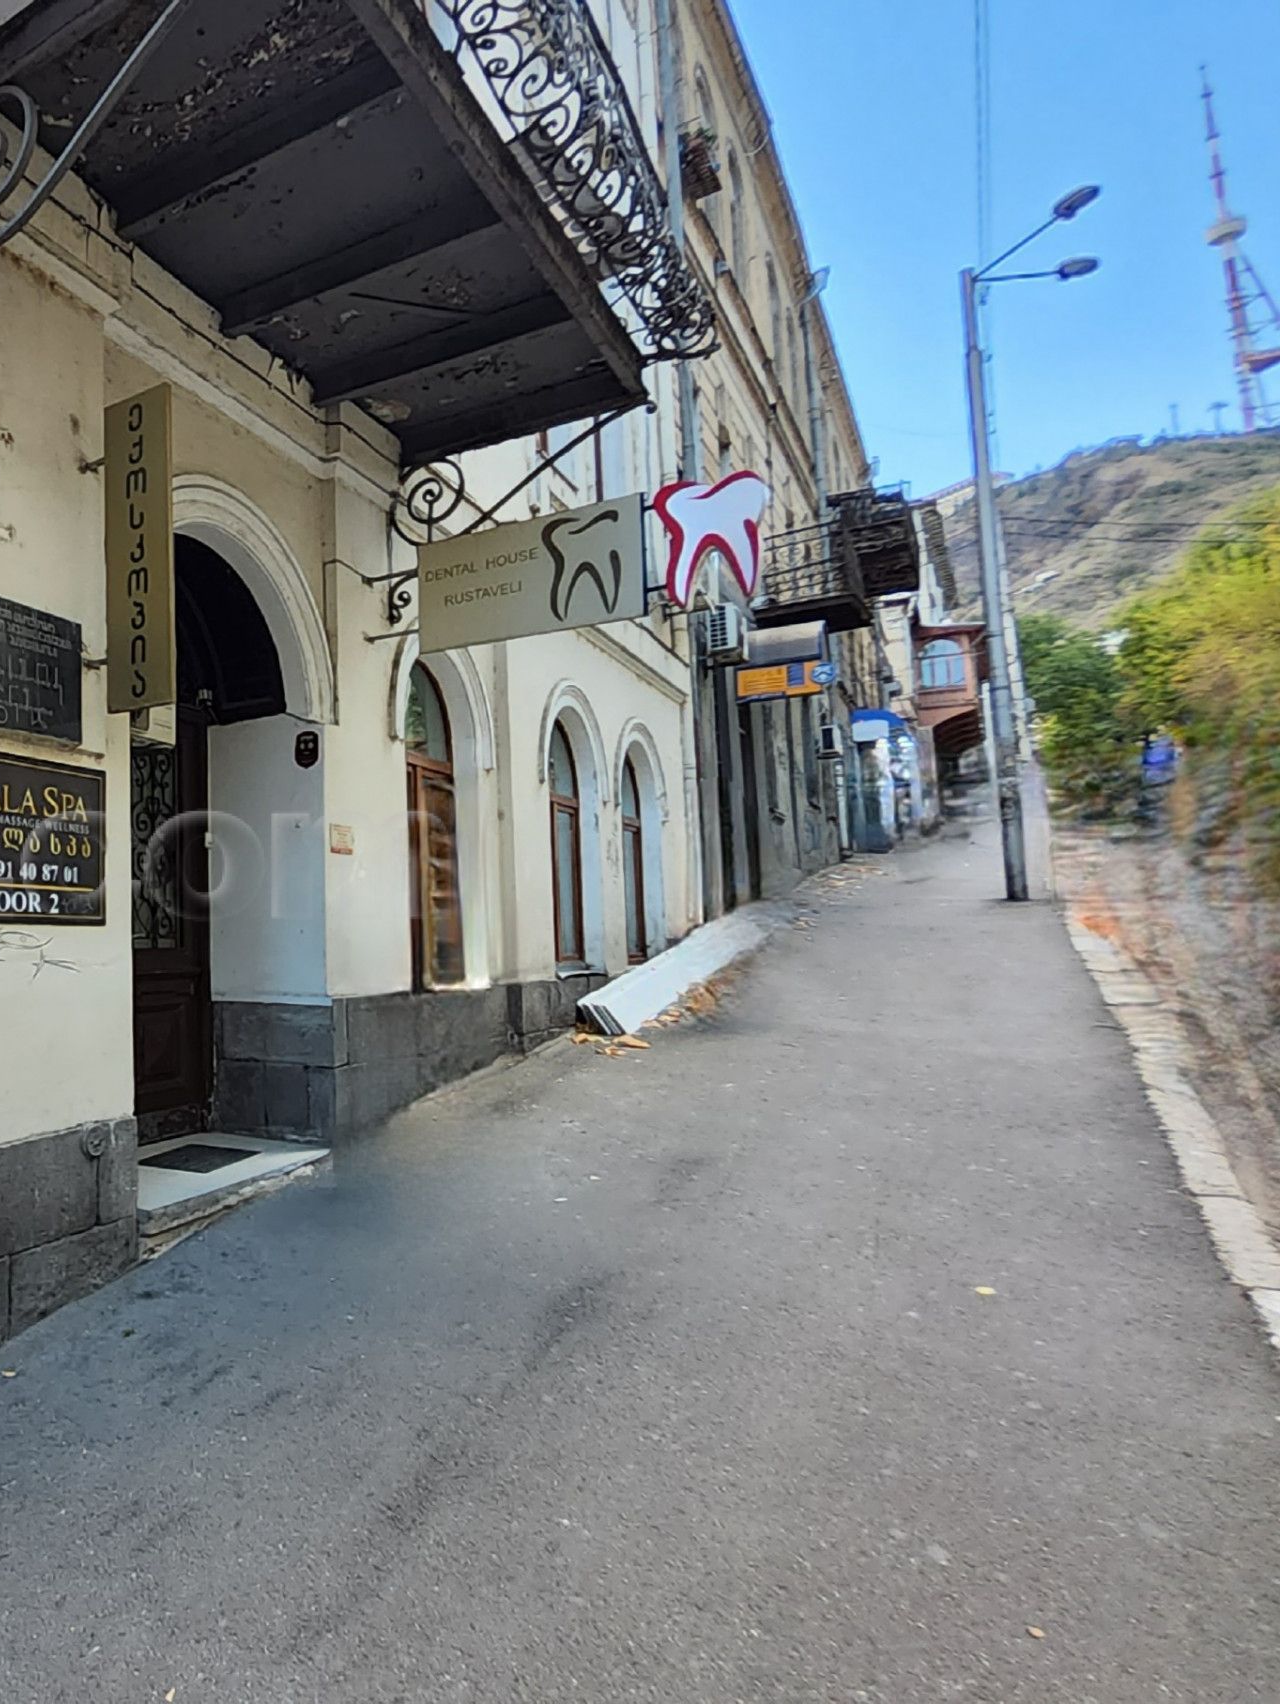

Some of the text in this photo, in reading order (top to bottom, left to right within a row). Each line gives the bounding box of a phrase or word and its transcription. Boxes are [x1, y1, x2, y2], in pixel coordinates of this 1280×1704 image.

[424, 546, 539, 583] DENTAL HOUSE
[444, 580, 523, 608] RUSTAVELI
[43, 786, 89, 823] SPA
[50, 832, 91, 858] სპა
[19, 861, 37, 881] 40
[42, 863, 59, 882] 87
[63, 865, 79, 884] 01
[49, 892, 60, 914] 2
